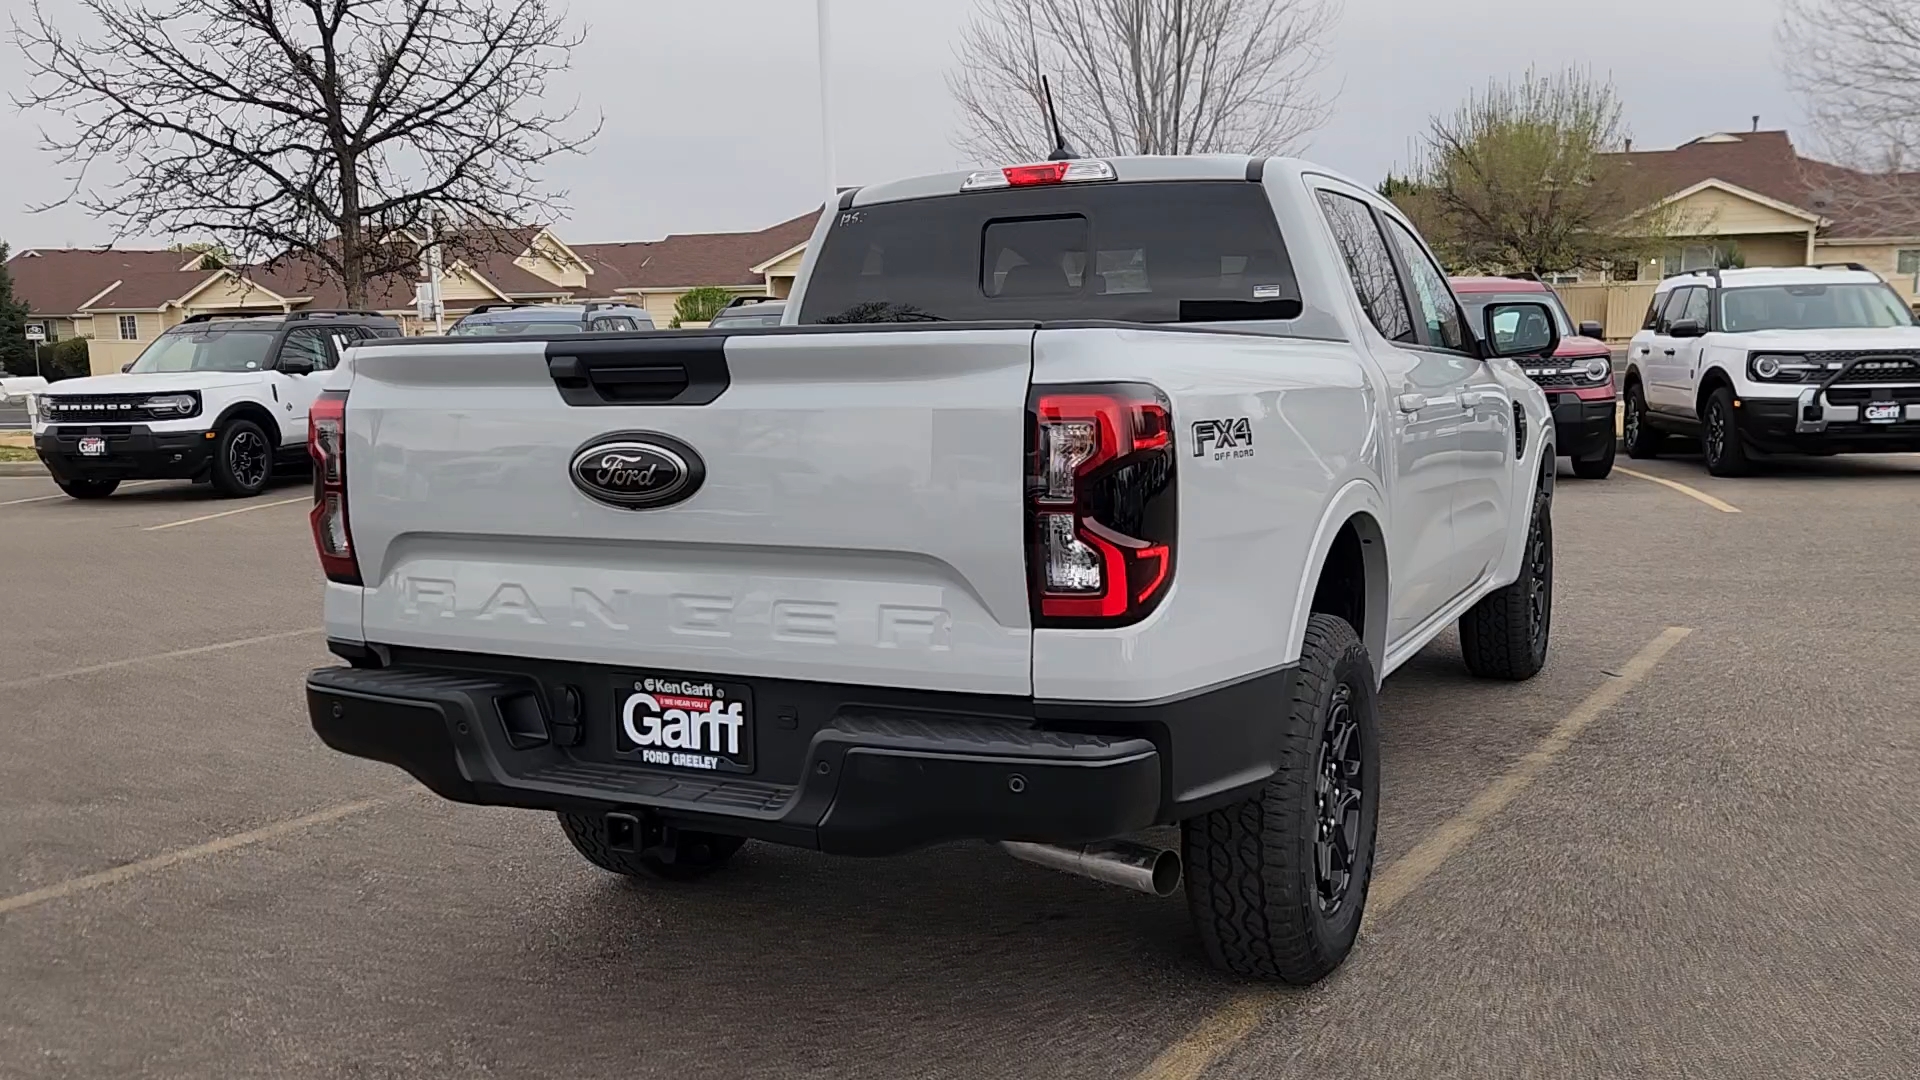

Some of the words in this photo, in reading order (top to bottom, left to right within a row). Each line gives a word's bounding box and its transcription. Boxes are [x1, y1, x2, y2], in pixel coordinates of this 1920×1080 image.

[1191, 417, 1252, 457] FX4
[596, 454, 657, 486] Ford
[1214, 452, 1231, 461] OFF
[1233, 448, 1254, 459] ROAD
[403, 576, 952, 651] RANGER
[655, 679, 680, 694] Ken
[681, 681, 713, 697] Garff
[622, 692, 743, 754] Garff
[643, 750, 670, 764] FORD
[671, 753, 718, 769] GREELEY
